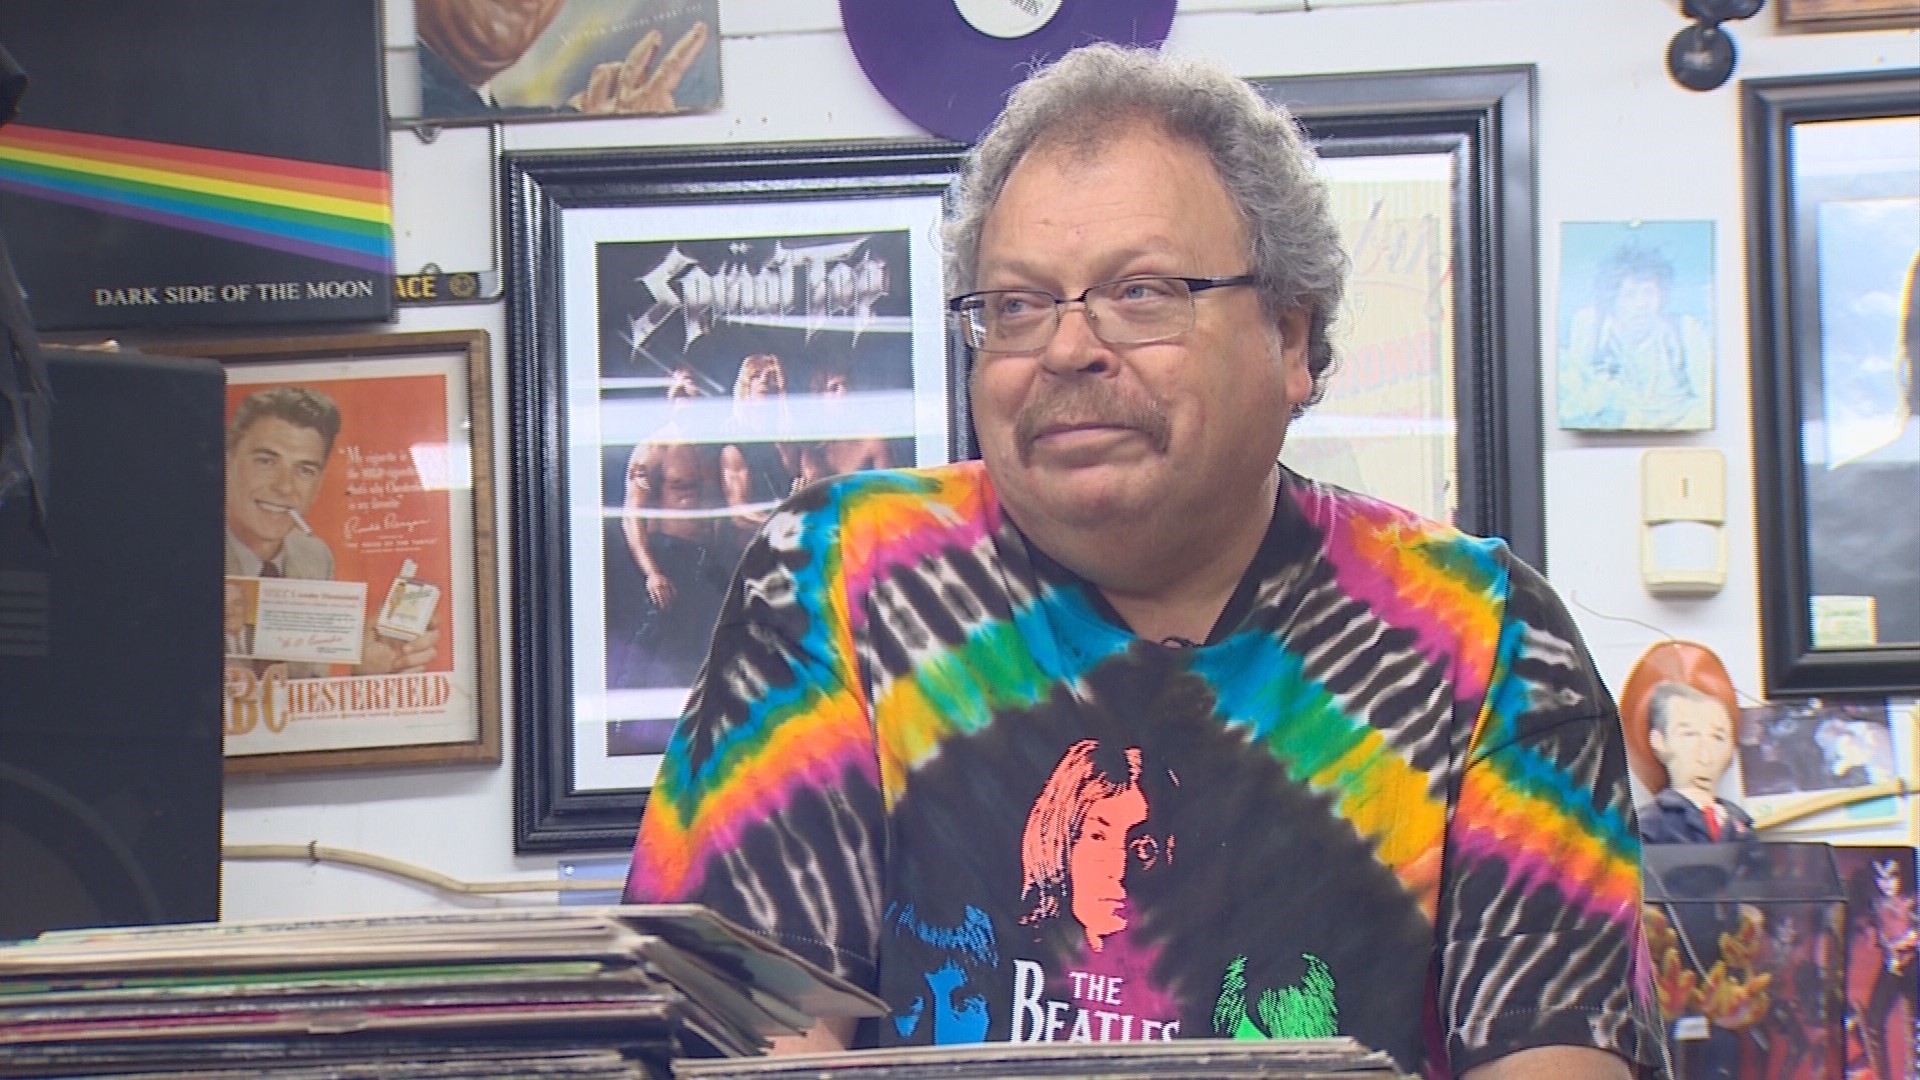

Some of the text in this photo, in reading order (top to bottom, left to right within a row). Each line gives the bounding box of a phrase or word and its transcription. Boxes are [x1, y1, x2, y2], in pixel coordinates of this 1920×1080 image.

[95, 279, 375, 307] DARK SIDE OF THE MOON
[1069, 971, 1124, 1006] THE
